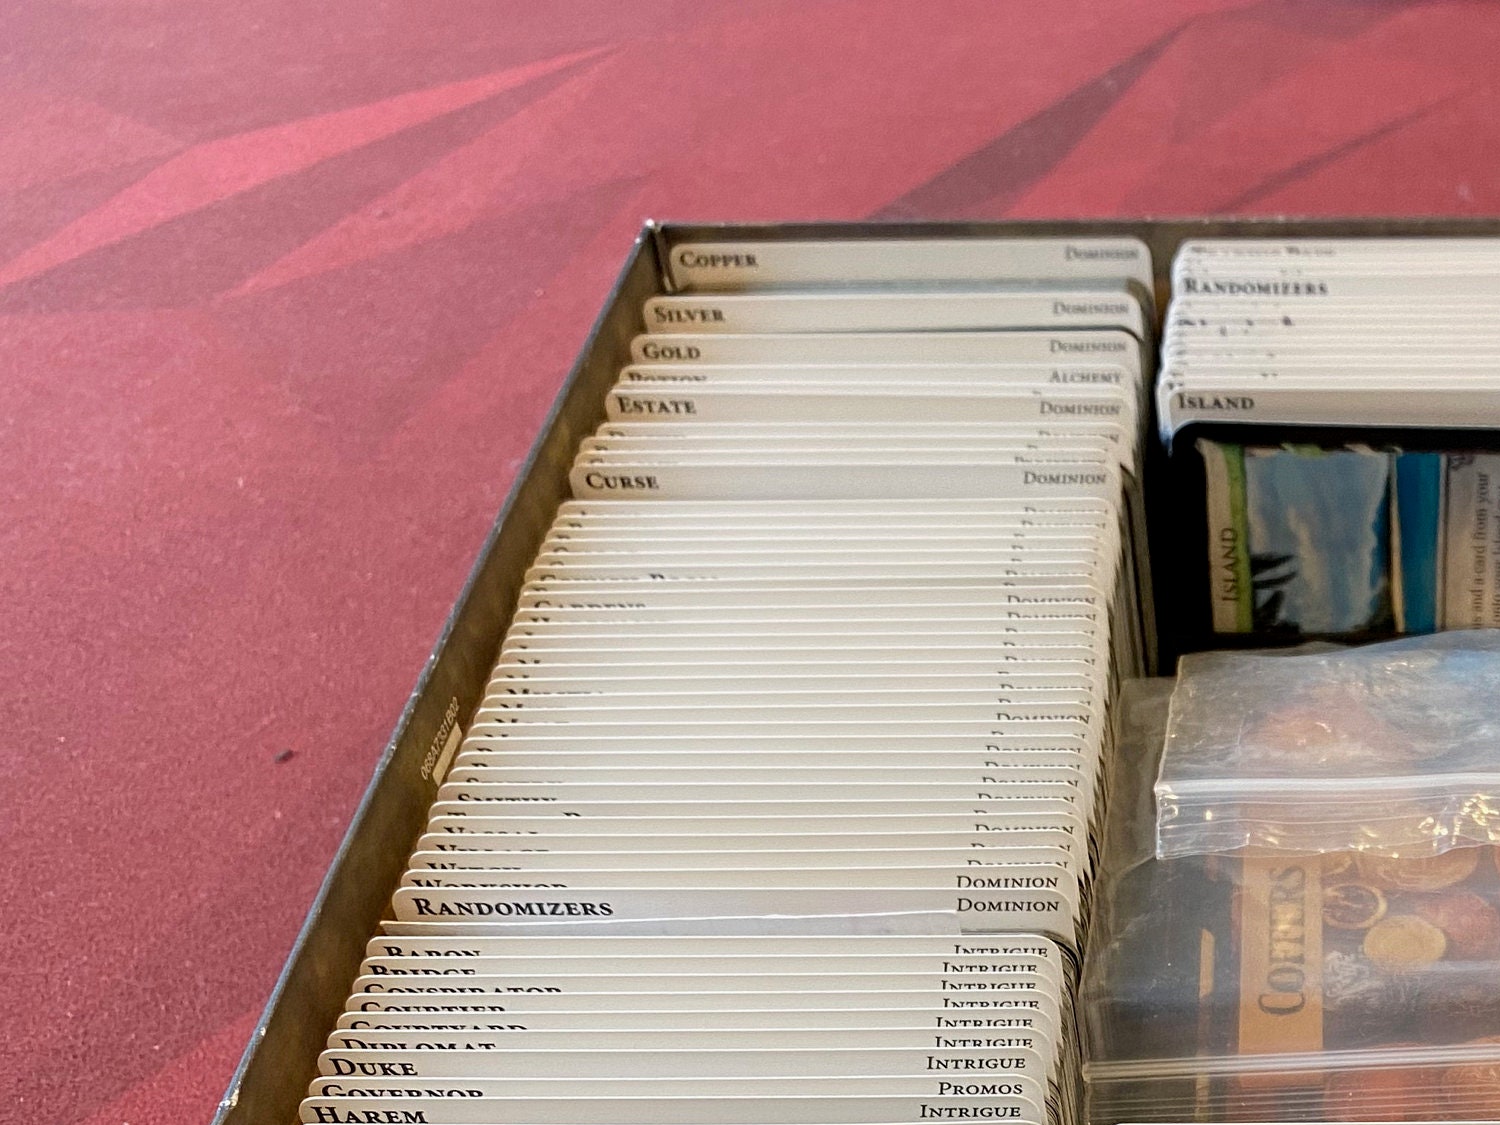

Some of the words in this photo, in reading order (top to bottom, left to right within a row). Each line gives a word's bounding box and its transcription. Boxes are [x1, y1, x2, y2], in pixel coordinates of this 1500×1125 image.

[680, 252, 758, 268] COPPER
[1065, 246, 1138, 261] DOMINION
[1184, 280, 1328, 295] RANDOMIZERS
[654, 307, 725, 323] SILVER
[1052, 302, 1129, 317] DOMINION
[642, 343, 700, 359] GOLD
[1050, 340, 1126, 353] DOMINION
[1050, 370, 1121, 384] ALCHEMY
[618, 398, 696, 415] ESTATE
[1039, 401, 1120, 416] DOMINION
[1178, 394, 1254, 410] ISLAND
[586, 473, 659, 491] CURSE
[1023, 471, 1107, 485] DOMINION
[1477, 472, 1492, 504] your
[1472, 509, 1487, 540] from
[1221, 528, 1238, 602] ISLAND
[957, 876, 1058, 889] DOMINION
[412, 898, 613, 917] RANDOMIZERS
[958, 899, 1059, 912] DOMINION
[1258, 865, 1308, 1016] COFFERS
[329, 1058, 418, 1076] DUKE
[927, 1056, 1026, 1070] INTRIGUE
[939, 1082, 1022, 1095] PROMOS
[311, 1107, 428, 1124] HAREM
[920, 1104, 1020, 1118] INTRIGUE
